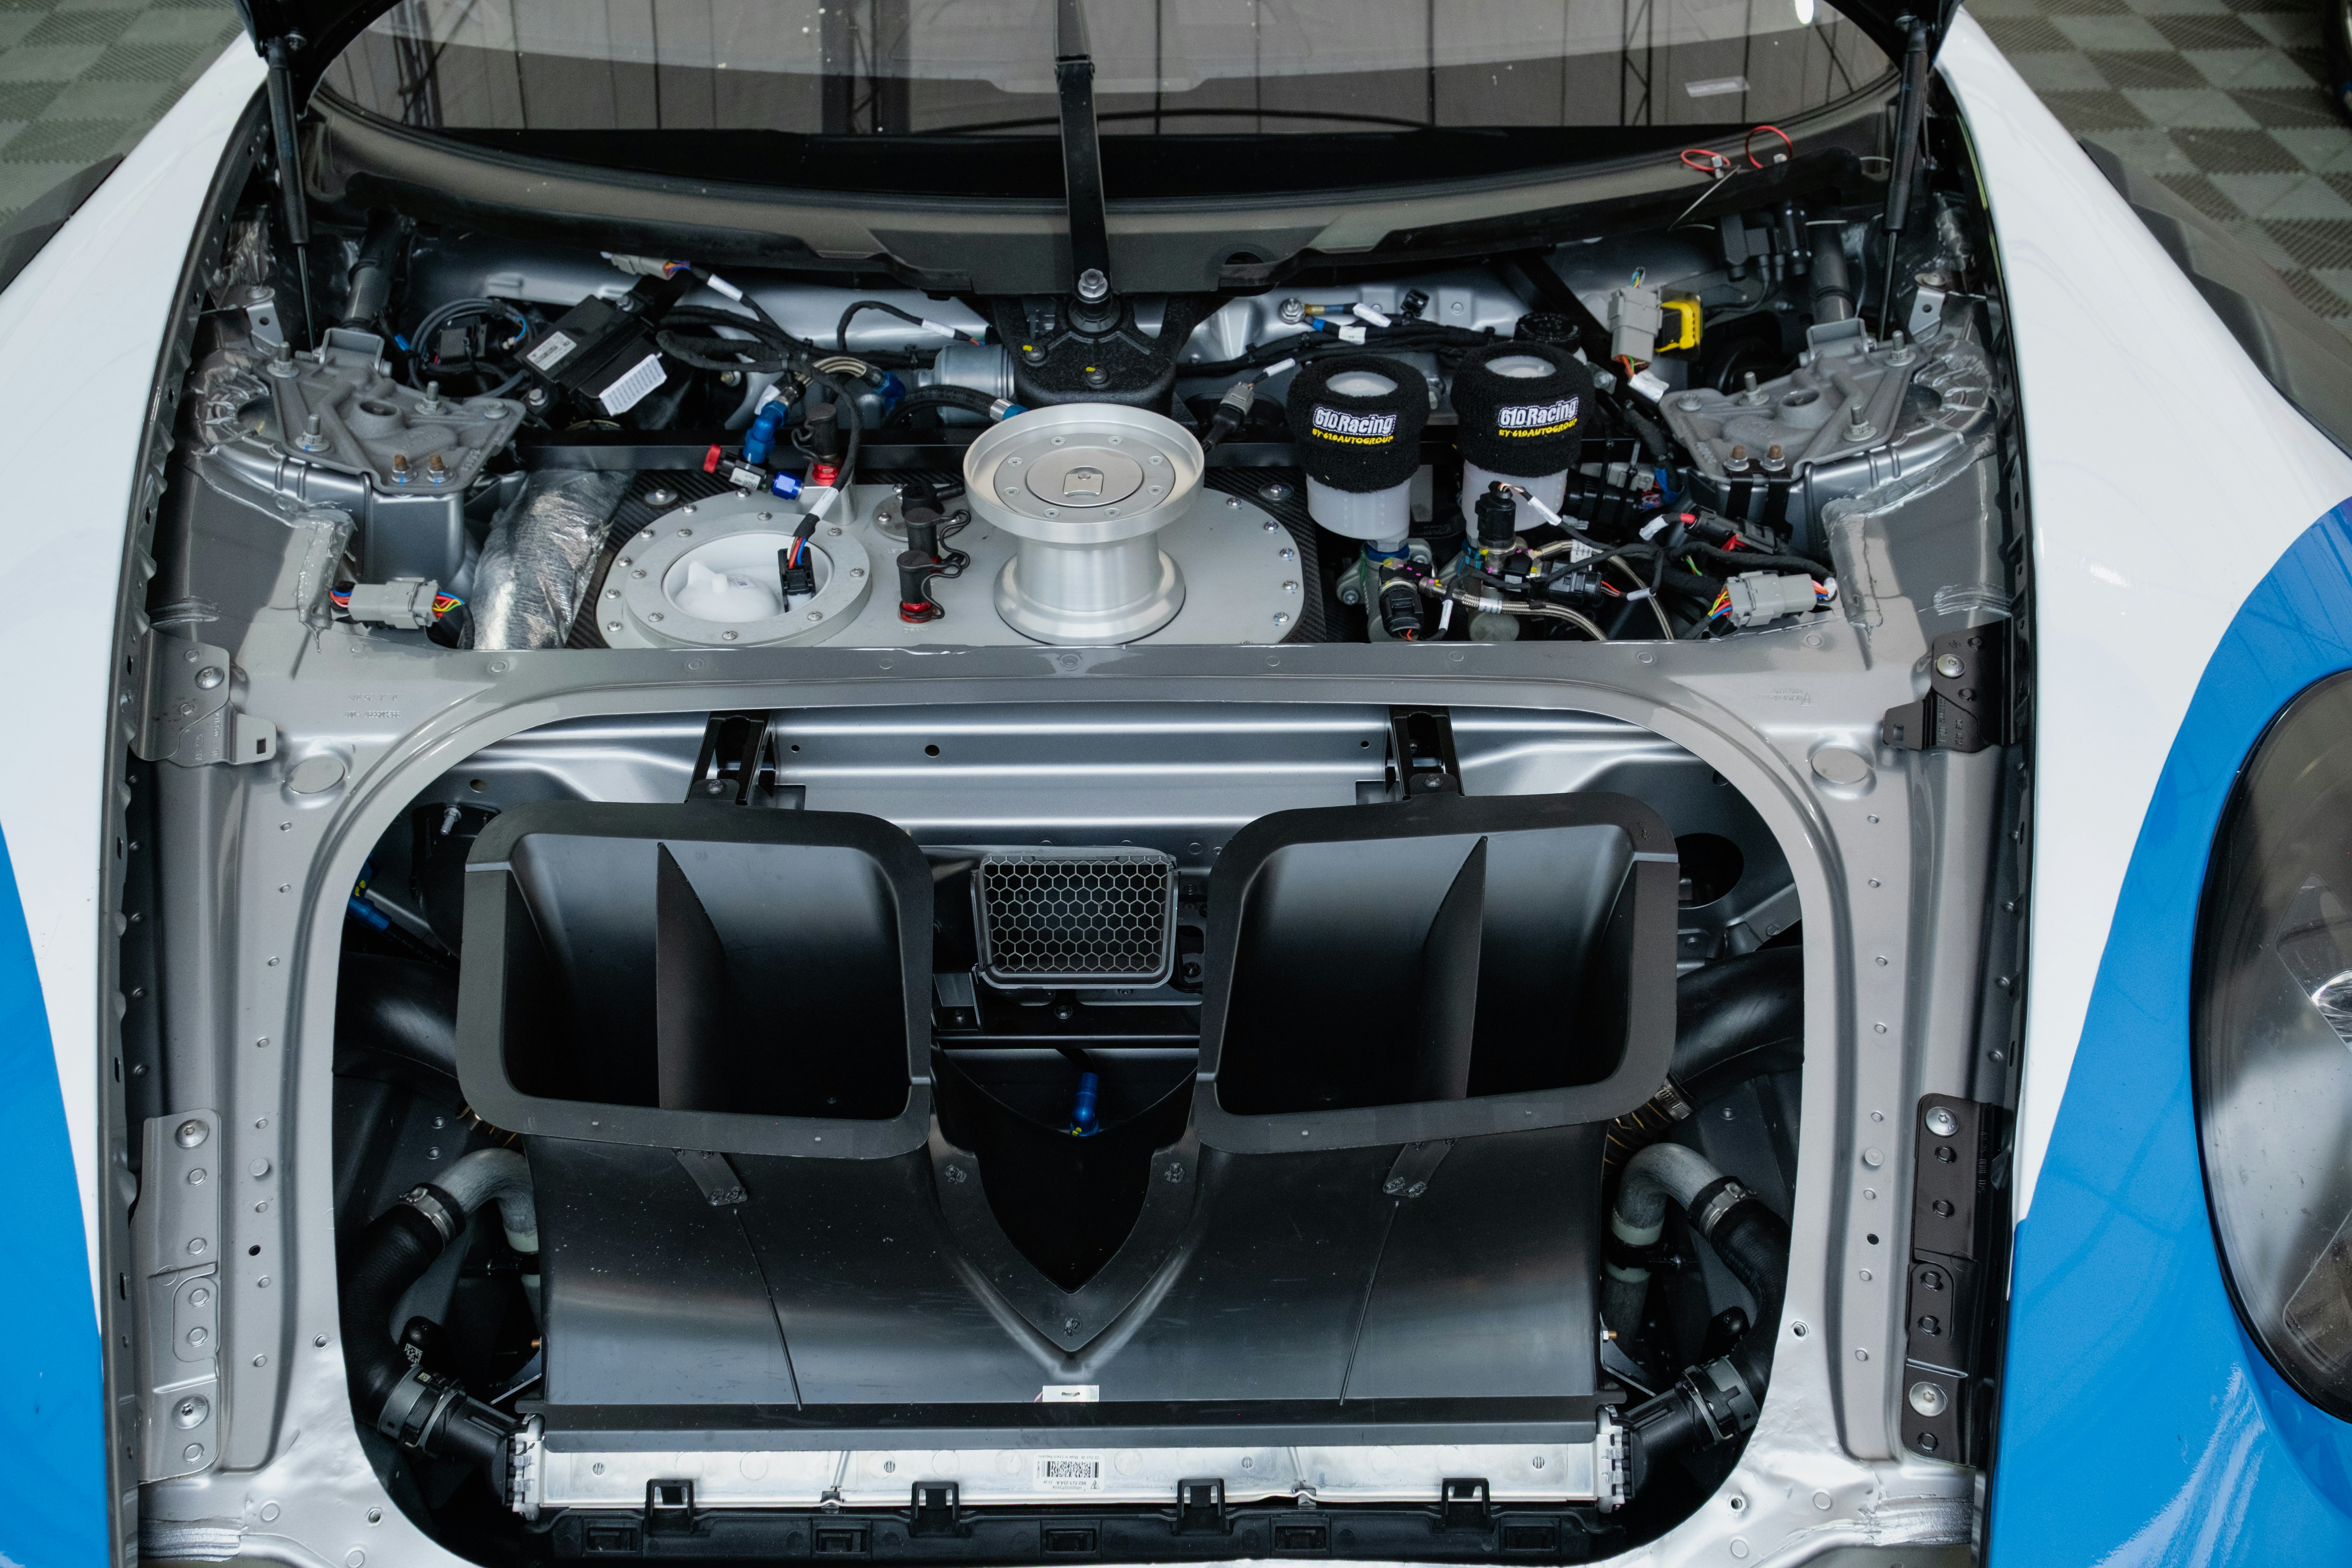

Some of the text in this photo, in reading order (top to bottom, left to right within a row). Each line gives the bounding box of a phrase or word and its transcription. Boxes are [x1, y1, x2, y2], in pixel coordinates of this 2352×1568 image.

[1315, 409, 1394, 434] 610 Racing
[1501, 400, 1577, 426] 610 Racing
